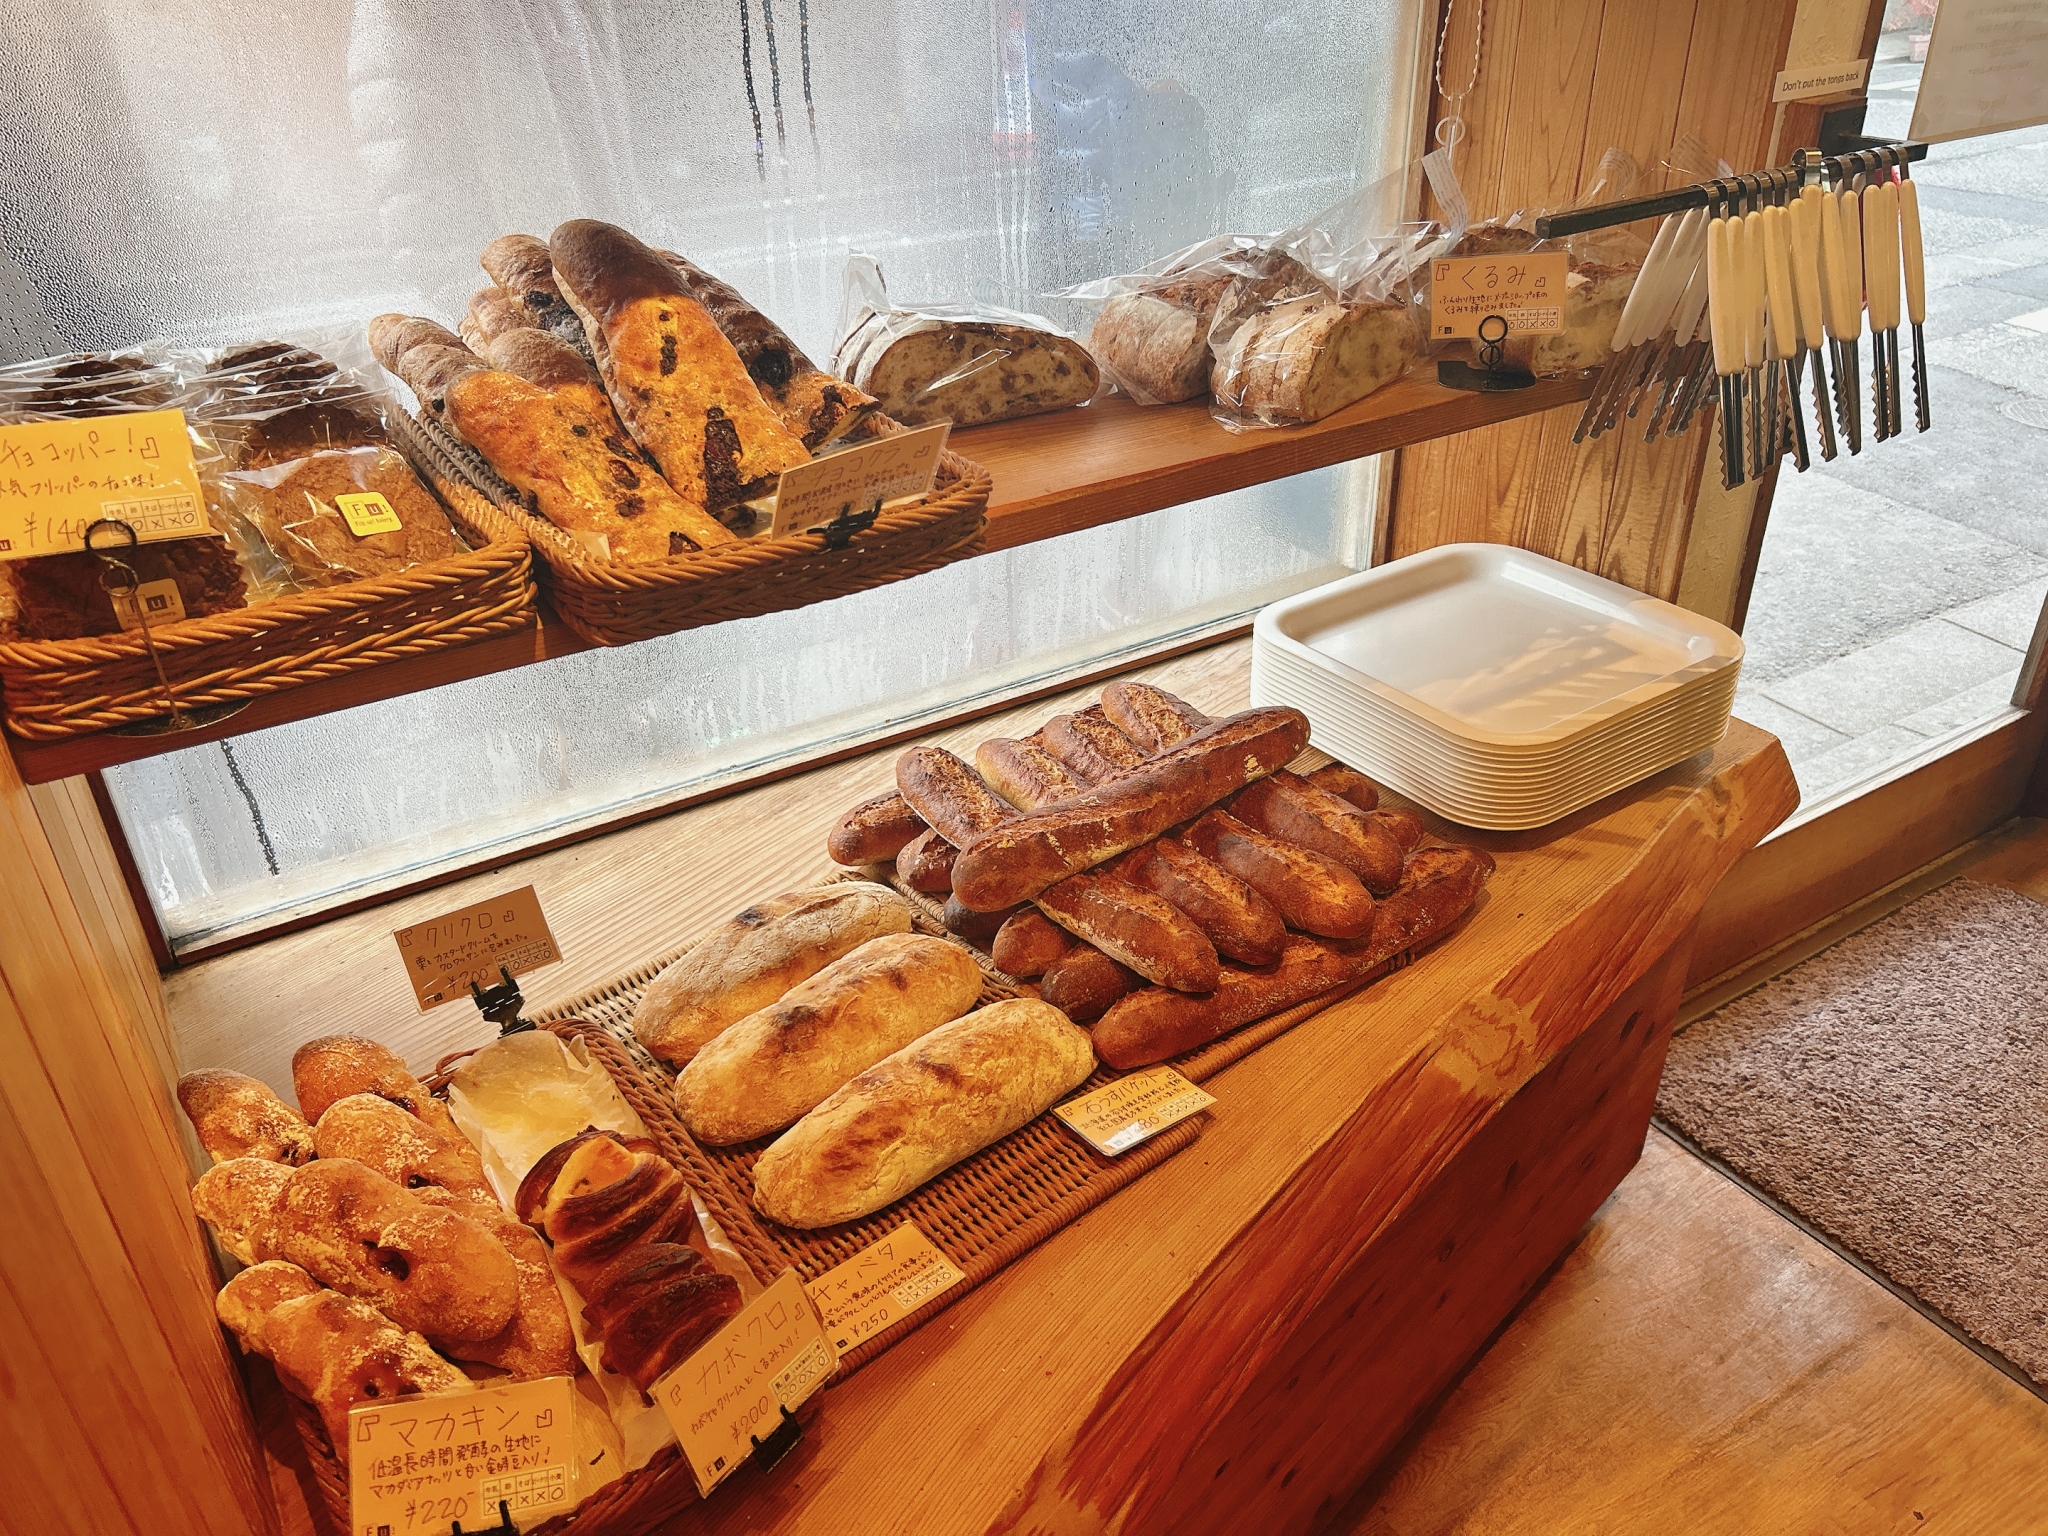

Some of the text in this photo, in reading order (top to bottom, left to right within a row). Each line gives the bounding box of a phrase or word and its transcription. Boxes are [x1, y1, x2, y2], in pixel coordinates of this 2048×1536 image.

[1783, 70, 1859, 91] Don't put the tongs back
[351, 503, 389, 516] Fu!
[849, 1308, 889, 1337] ¥250
[730, 1395, 769, 1445] ¥200
[369, 1434, 542, 1480] 低温長時間発酵の生地に
